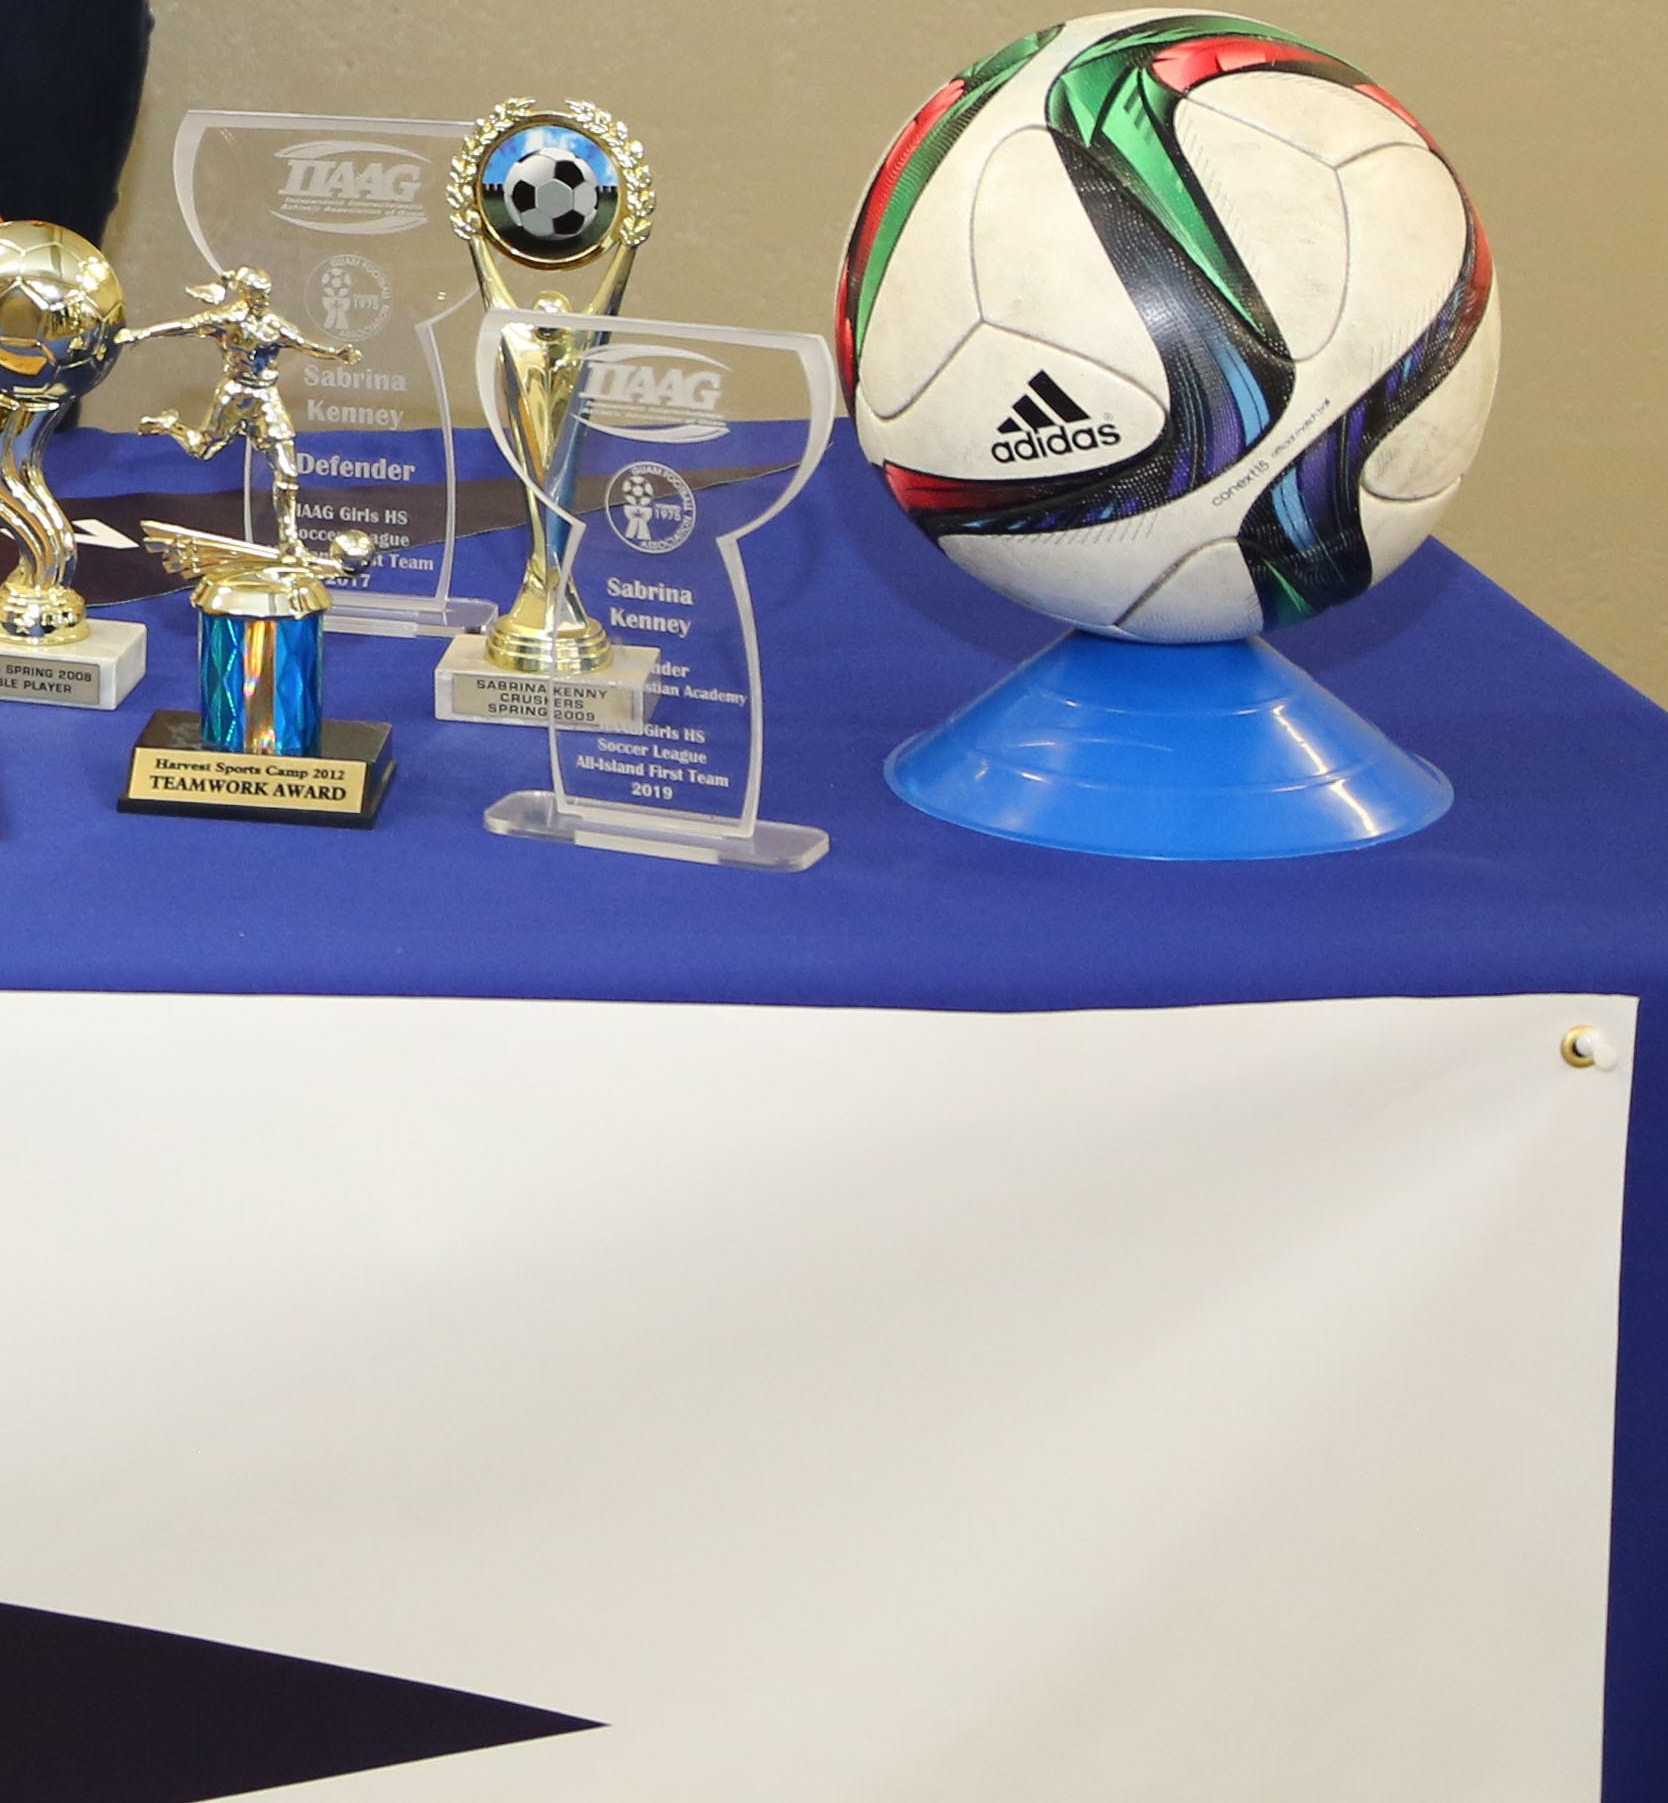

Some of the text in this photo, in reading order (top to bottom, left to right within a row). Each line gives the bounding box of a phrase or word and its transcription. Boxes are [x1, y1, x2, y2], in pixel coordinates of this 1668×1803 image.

[304, 365, 408, 392] Sabrina
[307, 399, 404, 429] Kenney
[991, 423, 1121, 463] adidas
[296, 453, 416, 481] Defender
[297, 503, 408, 525] IAAG Girls HS
[298, 529, 410, 549] occe ague
[389, 554, 434, 570] Team
[607, 577, 694, 605] Sabrina
[610, 607, 692, 637] Kenney
[6, 664, 53, 678] SPRING
[58, 670, 92, 682] 2008
[23, 680, 72, 694] PLAYER
[477, 679, 608, 699] SABRINA KENNY
[683, 686, 748, 706] Academy
[488, 703, 596, 722] SPRING 2009
[644, 723, 680, 740] Girls
[684, 728, 706, 744] HS
[597, 738, 707, 765] Soccer League
[155, 758, 345, 780] Harvest Sports Camp 2012
[576, 755, 729, 788] All-Island First Team
[149, 775, 347, 801] TEAMWORK AWARD
[631, 782, 674, 799] 2019
